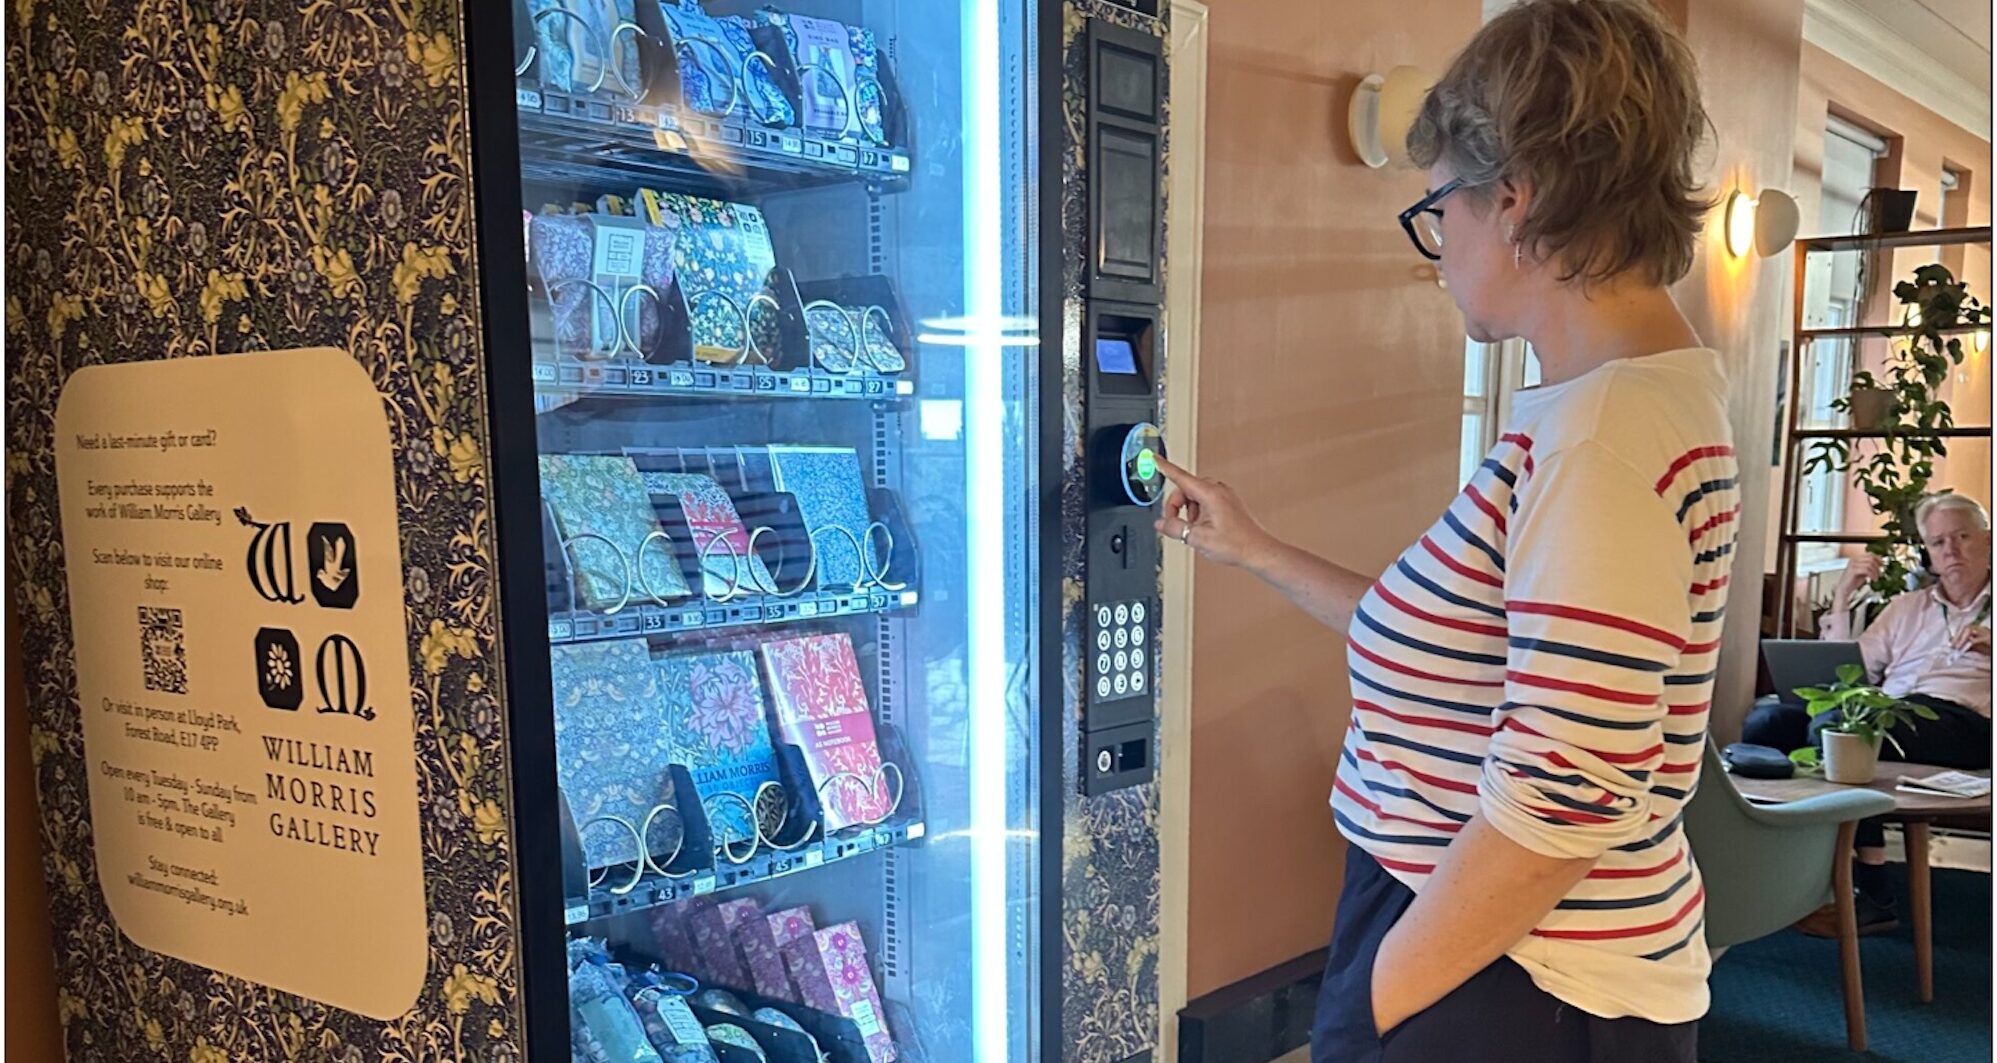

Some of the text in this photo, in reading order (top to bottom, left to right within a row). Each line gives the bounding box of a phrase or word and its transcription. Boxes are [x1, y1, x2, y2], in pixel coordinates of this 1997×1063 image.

[620, 108, 635, 122] 13
[750, 132, 762, 144] 15
[863, 153, 874, 165] 17
[633, 371, 649, 384] 23
[868, 382, 880, 393] 27
[76, 429, 217, 453] Need a last-minute gift or card?
[87, 479, 214, 501] Every purchase supports the
[85, 502, 222, 526] work of William Morris Gallery
[92, 548, 224, 570] Scan below to visit our online
[143, 573, 169, 594] shop:
[647, 616, 661, 629] 33
[767, 605, 781, 618] 35
[102, 696, 242, 735] Or visit in person at Lloyd Park,
[124, 722, 219, 751] Forest Road, E17 4PP
[262, 735, 374, 778] WILLIAM
[101, 760, 125, 779] Open
[126, 769, 151, 788] every
[151, 770, 189, 795] Tuesday
[195, 778, 233, 804] Sunday
[233, 785, 258, 805] from
[695, 760, 771, 785] LIAM MORRIS
[124, 786, 134, 801] 10
[136, 792, 150, 805] am
[181, 797, 200, 816] The
[201, 801, 236, 828] Gallery
[265, 773, 377, 818] MORRIS
[137, 810, 224, 843] is free & open to all
[269, 813, 380, 857] GALLERY
[148, 855, 219, 886] Stay connected:
[775, 861, 789, 873] 45
[127, 871, 249, 917] williammorrisgallery.org.uk
[658, 888, 674, 901] 43
